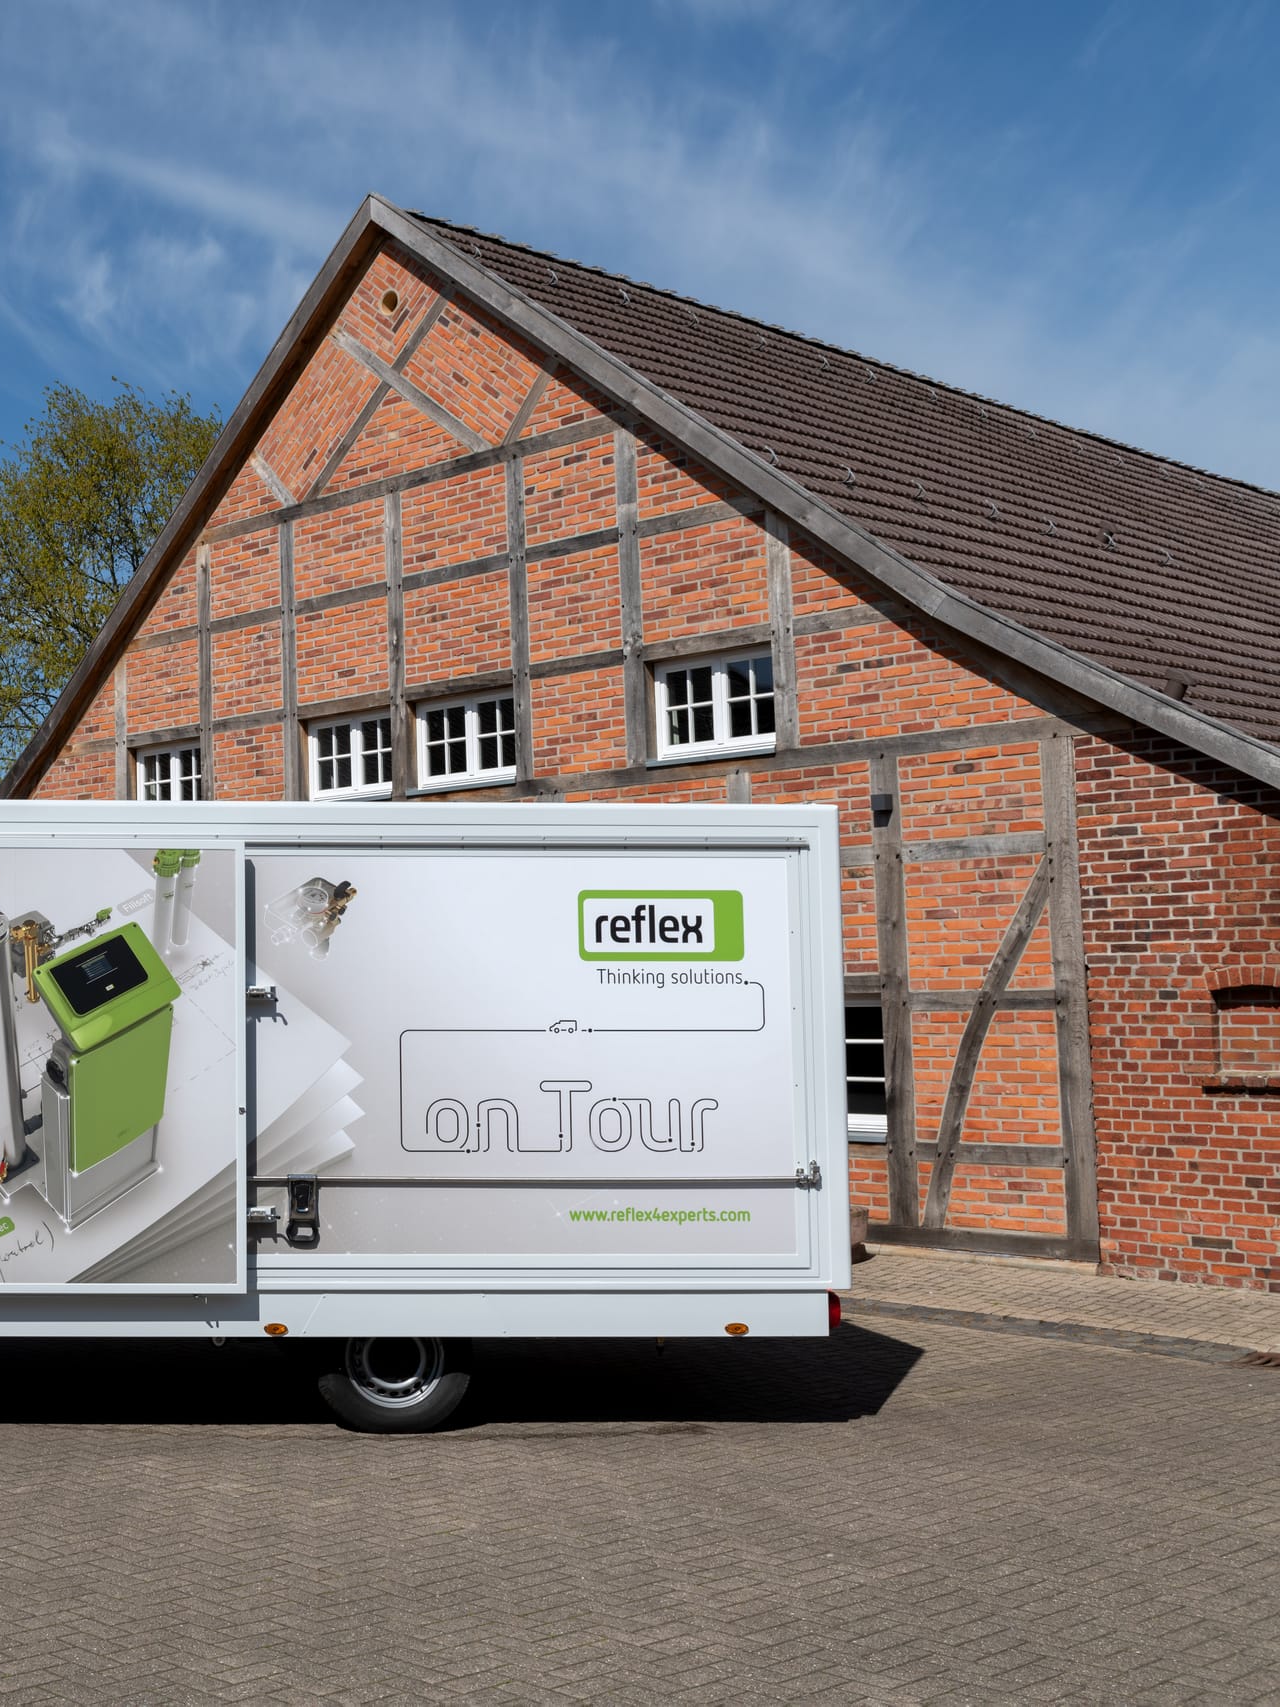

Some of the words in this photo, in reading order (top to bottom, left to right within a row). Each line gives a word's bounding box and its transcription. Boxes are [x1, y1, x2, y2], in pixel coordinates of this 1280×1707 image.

[595, 904, 703, 944] reflex
[596, 968, 665, 989] Thinking
[426, 1098, 520, 1153] on
[539, 1080, 719, 1153] Tour
[569, 1207, 751, 1225] www.reflex4experts.com
